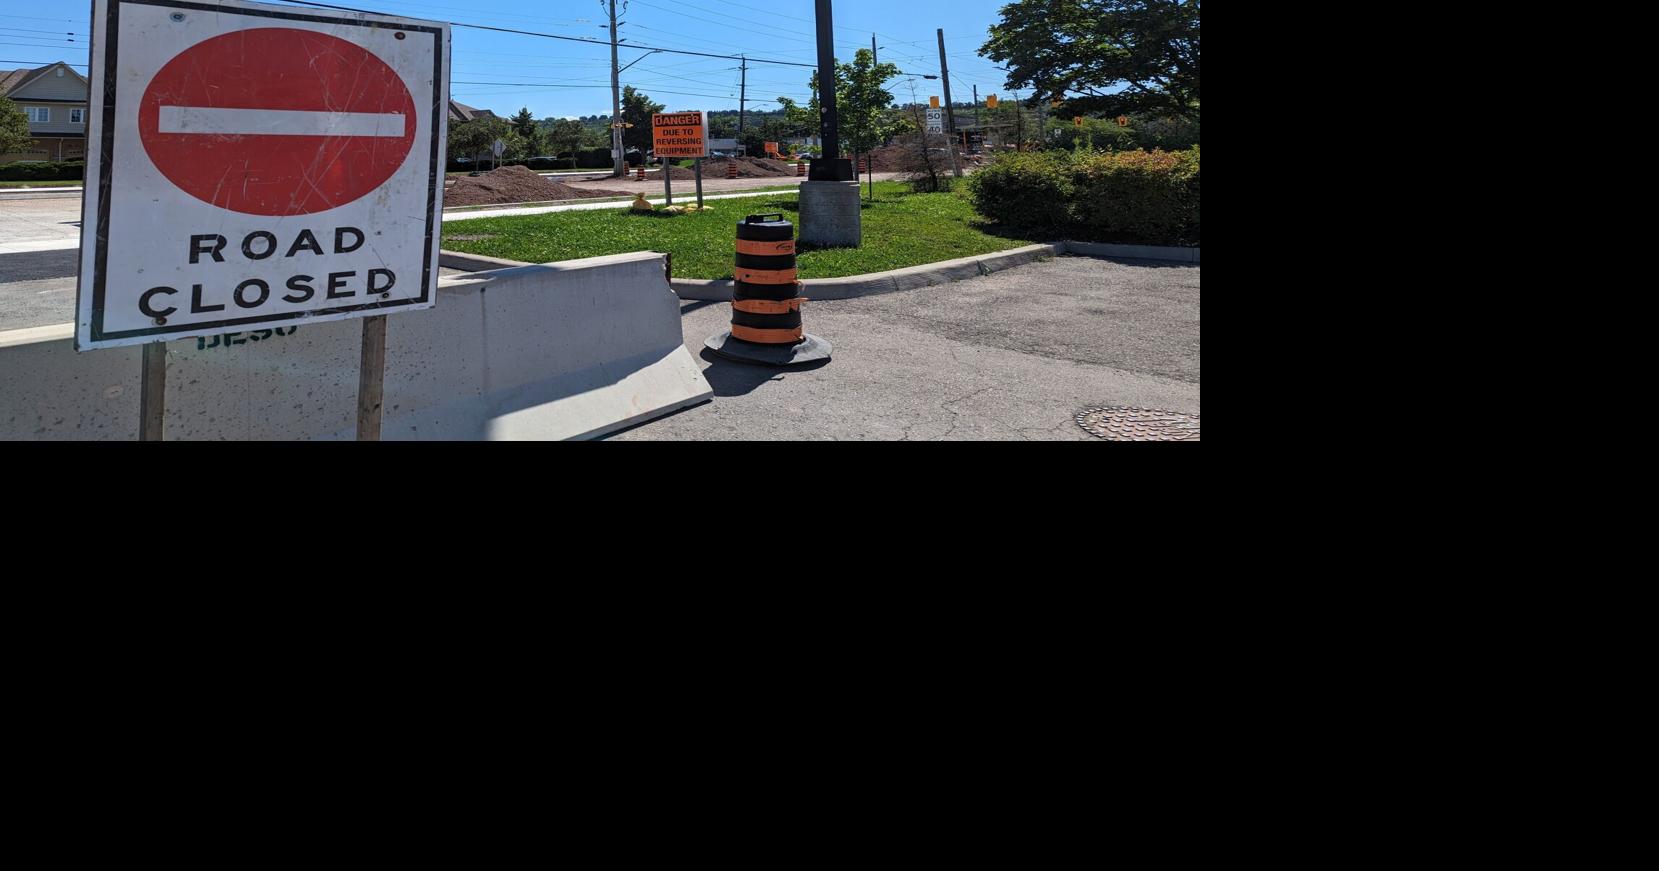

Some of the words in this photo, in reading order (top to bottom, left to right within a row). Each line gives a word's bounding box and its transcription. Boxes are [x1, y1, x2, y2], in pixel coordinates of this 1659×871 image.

[655, 115, 699, 125] DANGER
[188, 226, 366, 264] ROAD
[138, 268, 396, 318] CLOSED
